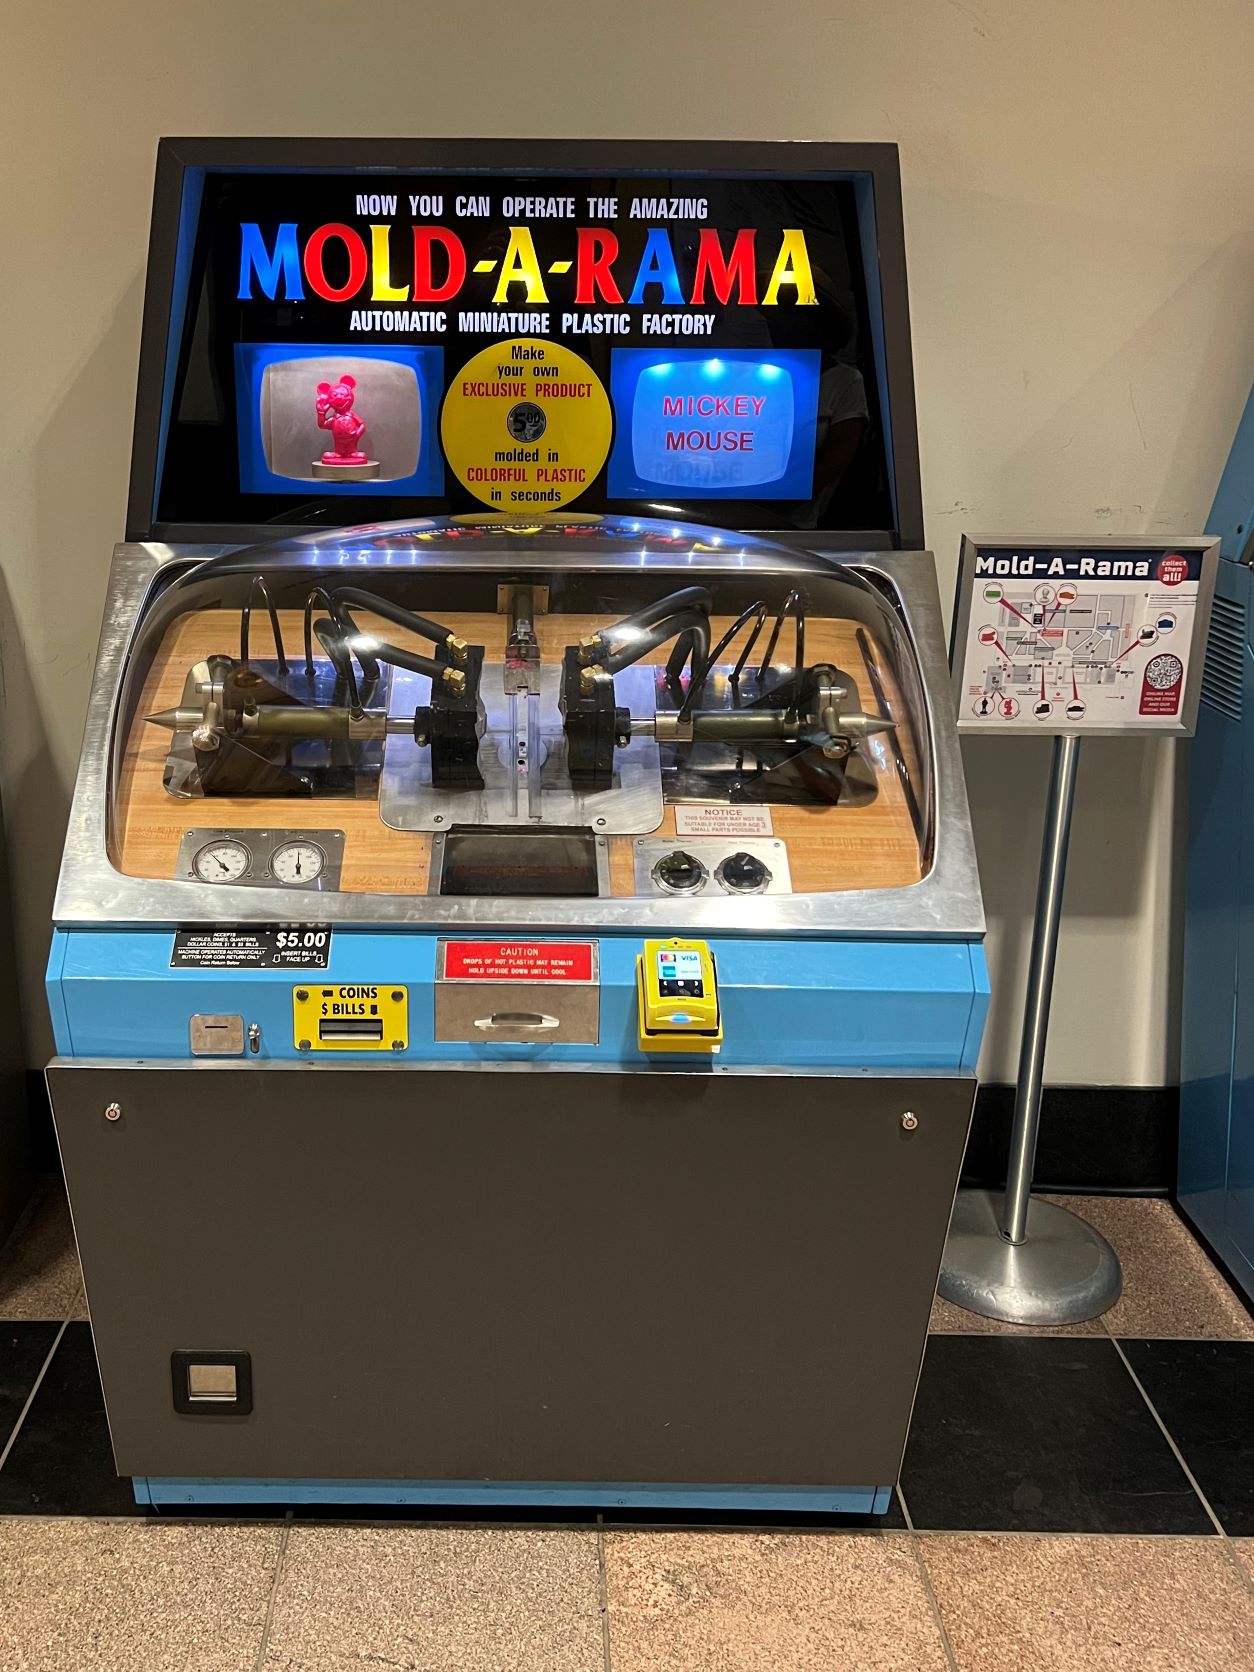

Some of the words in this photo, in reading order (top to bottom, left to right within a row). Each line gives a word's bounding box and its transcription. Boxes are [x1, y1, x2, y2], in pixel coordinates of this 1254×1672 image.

[356, 194, 398, 216] NOW
[408, 195, 444, 217] YOU
[455, 196, 490, 217] CAN
[502, 196, 576, 218] OPERATE
[586, 197, 618, 218] THE
[629, 198, 708, 219] AMAZING
[237, 222, 819, 306] MOLD-A-RAMA
[350, 310, 447, 332] AUTOMATIC
[458, 312, 550, 333] MINIATURE
[562, 313, 631, 334] PLASTIC
[642, 313, 716, 335] FACTORY
[511, 345, 545, 360] Make
[497, 365, 524, 379] your
[532, 366, 559, 377] own
[462, 382, 527, 397] EXCLUSIVE
[535, 383, 593, 398] PRODUCT
[663, 396, 767, 417] MICKEY
[666, 430, 754, 452] MOUSE
[494, 448, 539, 462] molded
[548, 448, 559, 462] in
[467, 467, 528, 482] COLORFUL
[536, 467, 586, 483] PLASTIC
[491, 487, 501, 501] in
[510, 488, 561, 502] seconds
[975, 555, 1149, 577] Mold-A-Rama
[1162, 572, 1182, 582] all!
[275, 931, 326, 949] $5.00
[500, 947, 539, 956] CAUTION
[338, 986, 378, 999] COINS
[321, 1001, 329, 1017] $
[332, 1002, 366, 1016] BILLS
